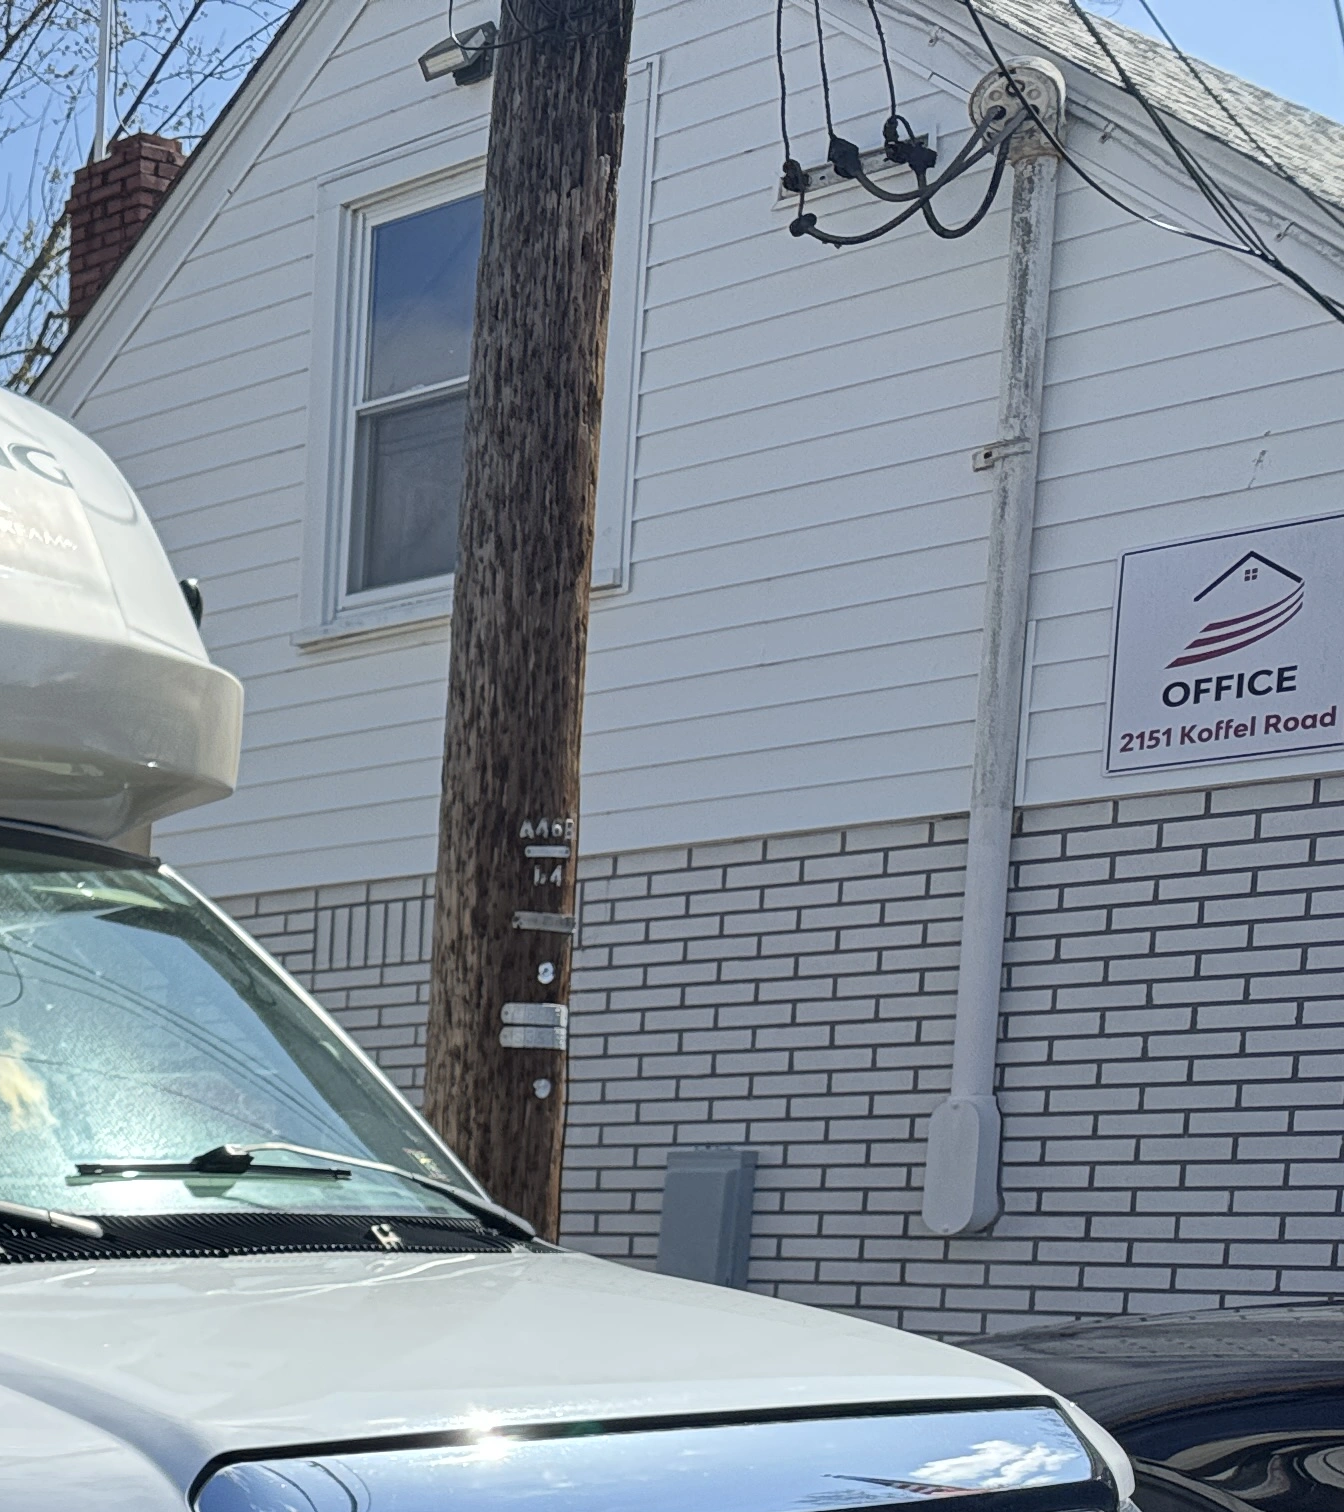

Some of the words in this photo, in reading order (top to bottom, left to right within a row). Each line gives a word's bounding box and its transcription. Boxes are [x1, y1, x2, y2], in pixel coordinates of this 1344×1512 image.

[1162, 665, 1298, 708] OFFICE
[1119, 727, 1173, 753] 2151
[1179, 716, 1257, 745] Koffel
[1264, 705, 1338, 735] Road
